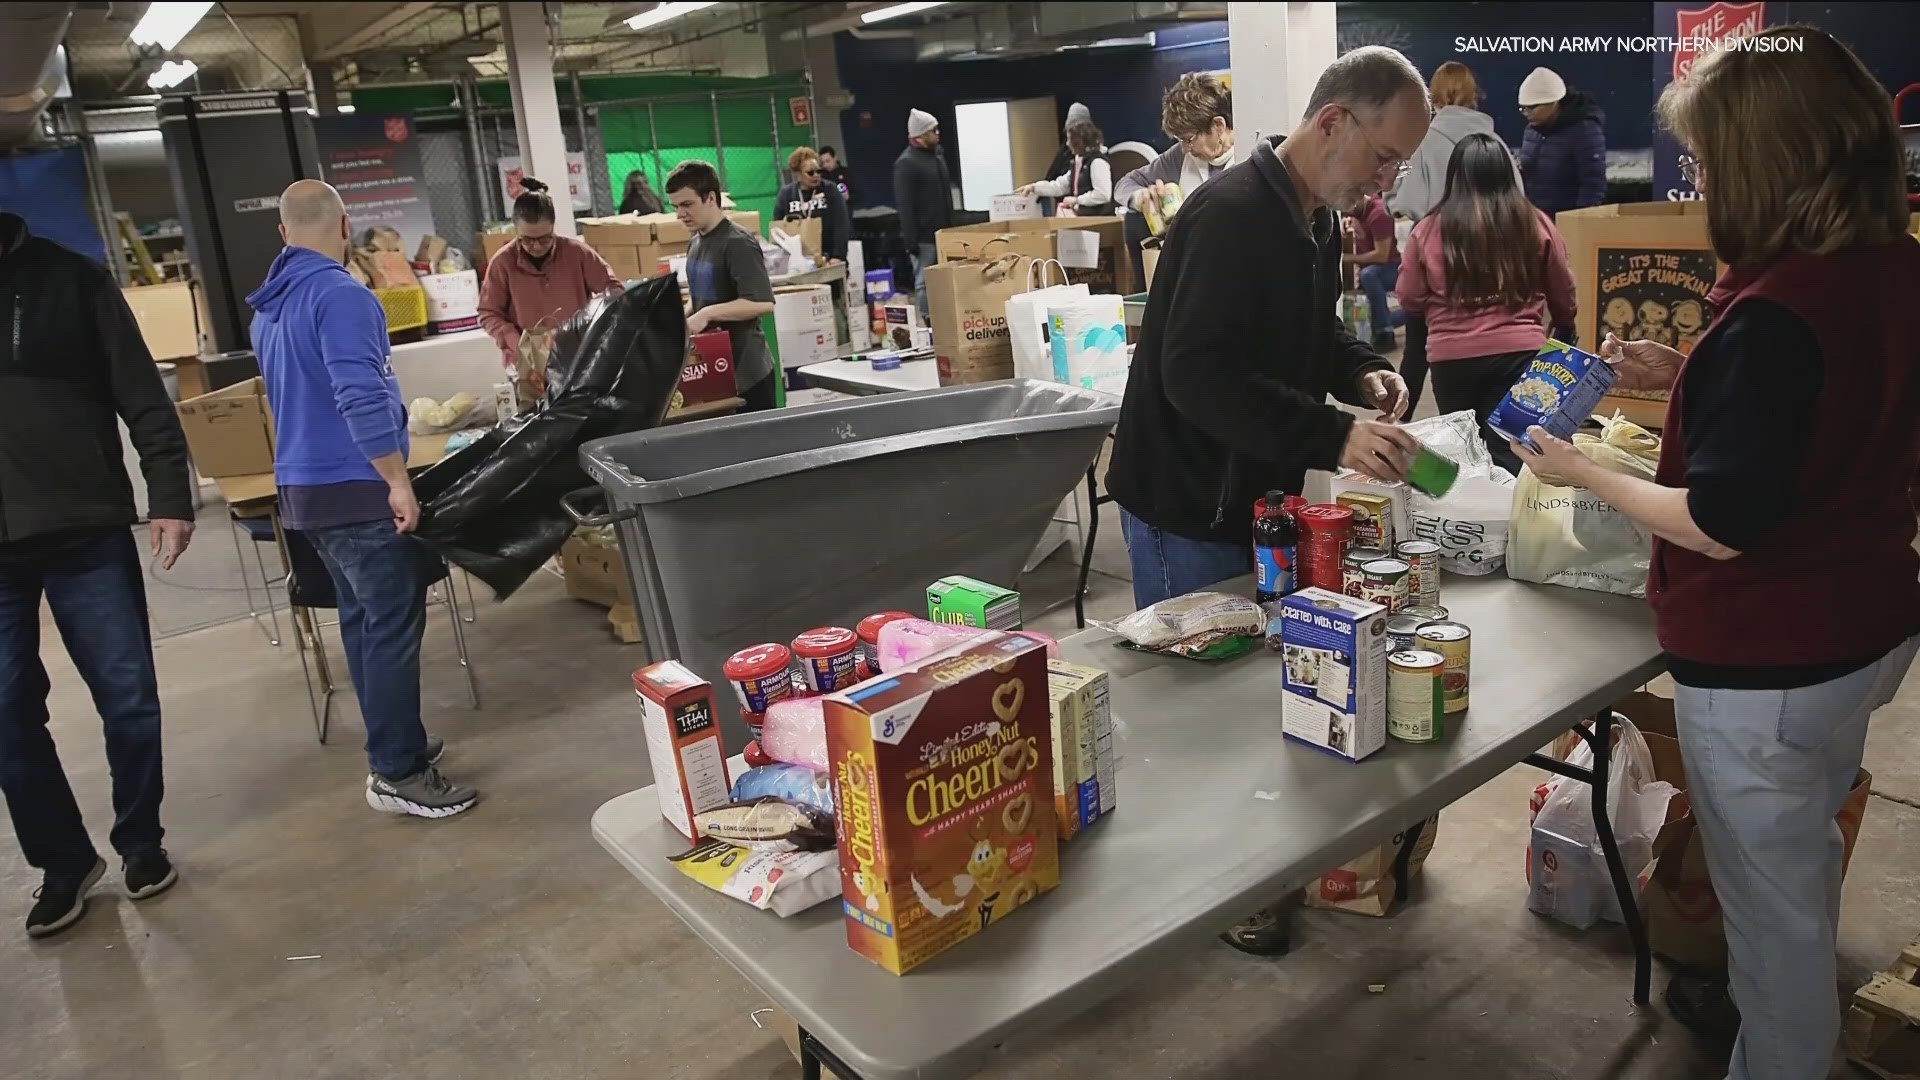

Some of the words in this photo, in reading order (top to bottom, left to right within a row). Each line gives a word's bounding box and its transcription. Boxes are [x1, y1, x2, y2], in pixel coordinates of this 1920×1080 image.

[1654, 254, 1680, 269] THE
[1602, 270, 1644, 293] GREAT
[1647, 268, 1710, 296] PUMPKIN
[963, 316, 990, 331] pick
[682, 363, 708, 380] SIAN
[832, 653, 855, 665] ARMO
[677, 708, 708, 728] THAI
[683, 721, 708, 732] KITCHEN
[920, 732, 960, 761] Limted
[951, 735, 998, 768] Honey
[997, 721, 1021, 748] Nut
[937, 812, 966, 832] HAPPY
[969, 796, 995, 817] HEART
[998, 780, 1027, 800] SHAPES
